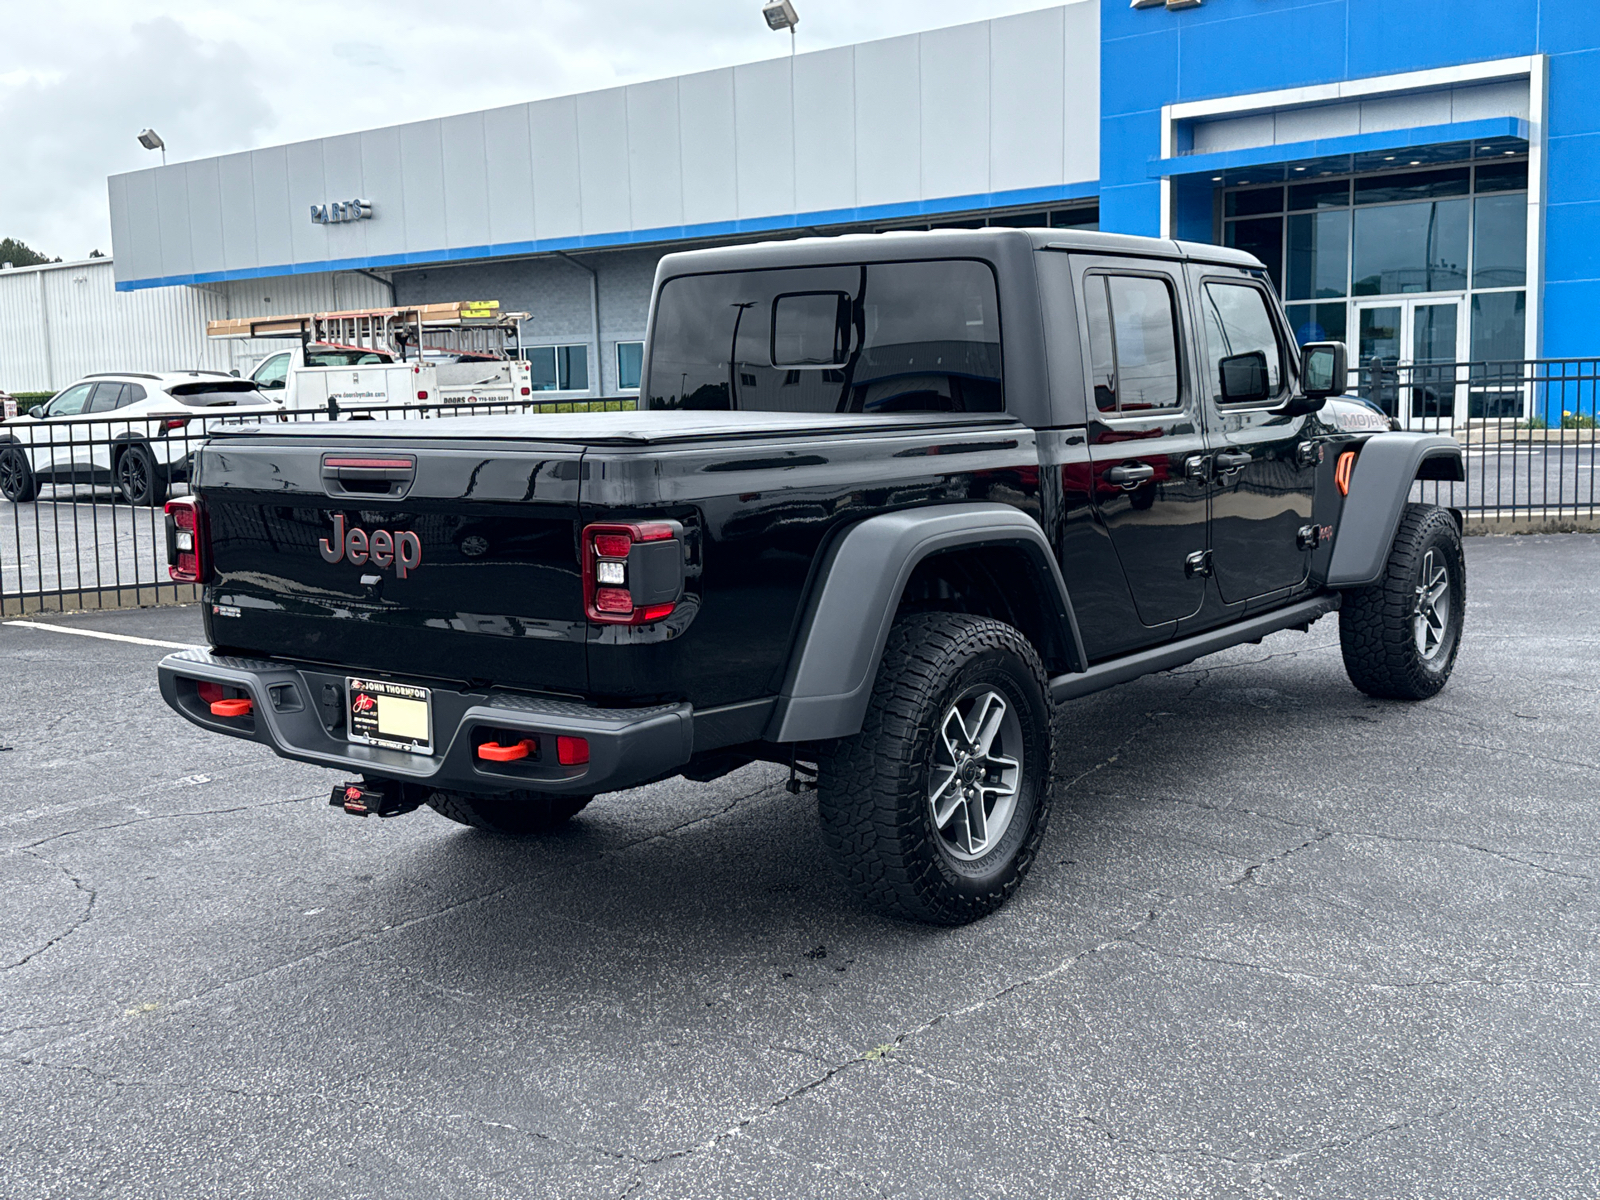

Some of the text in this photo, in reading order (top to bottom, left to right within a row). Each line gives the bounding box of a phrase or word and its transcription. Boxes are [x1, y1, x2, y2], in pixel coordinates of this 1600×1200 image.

[310, 199, 368, 223] PARTS
[318, 514, 421, 579] Jeep
[365, 681, 426, 698] JOHN THORNTON
